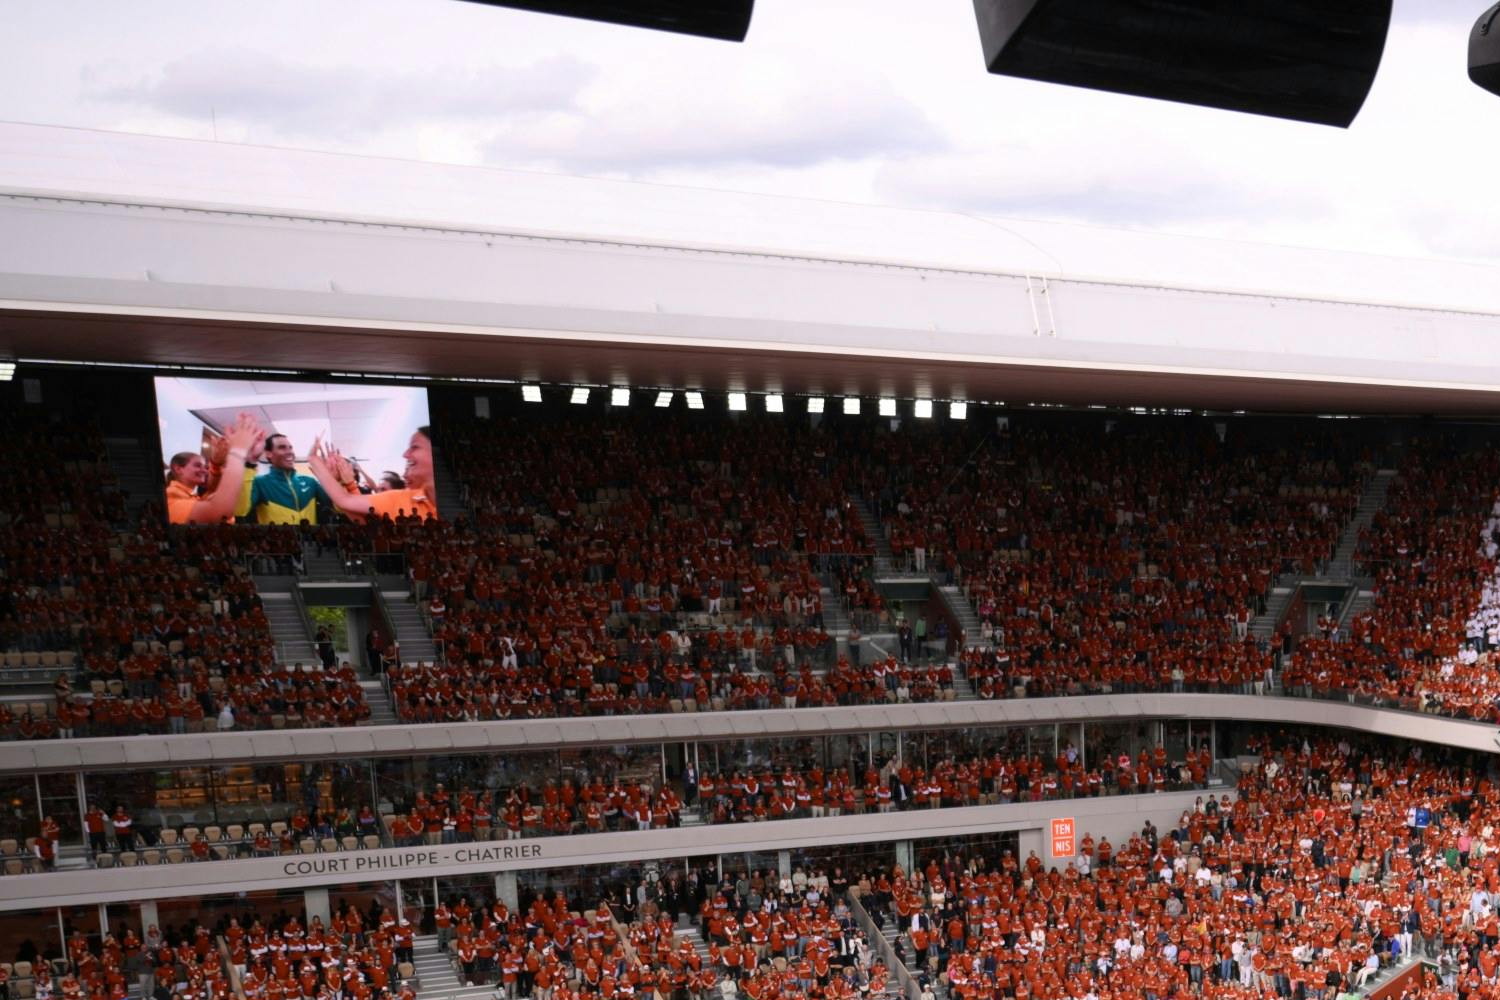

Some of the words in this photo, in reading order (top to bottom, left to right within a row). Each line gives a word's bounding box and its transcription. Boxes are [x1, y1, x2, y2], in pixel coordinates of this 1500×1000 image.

[1055, 823, 1071, 835] TEN
[1055, 841, 1071, 853] NIS
[283, 858, 349, 877] COURT
[355, 851, 439, 871] PHILIPPE
[454, 844, 542, 864] CHATRIER
